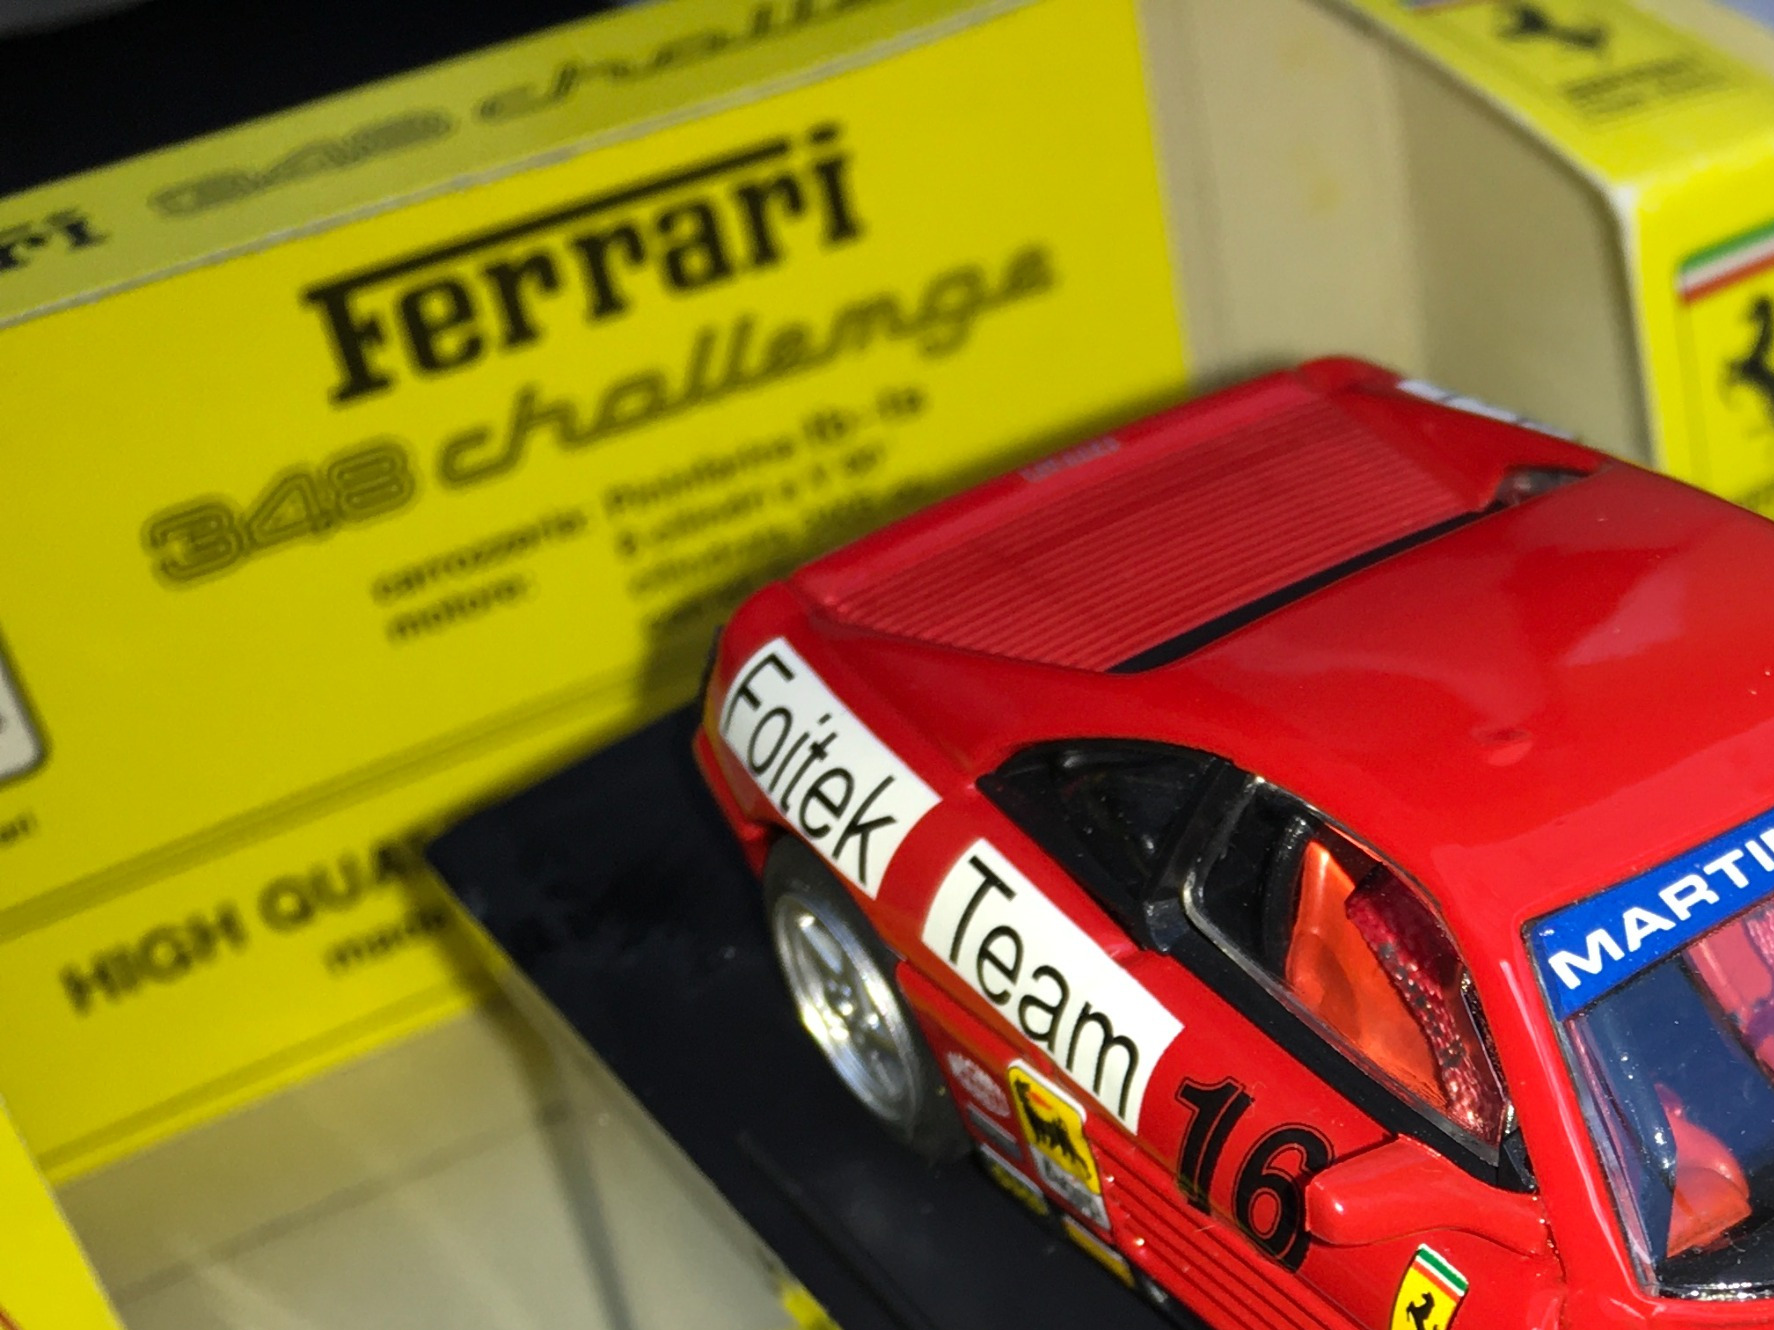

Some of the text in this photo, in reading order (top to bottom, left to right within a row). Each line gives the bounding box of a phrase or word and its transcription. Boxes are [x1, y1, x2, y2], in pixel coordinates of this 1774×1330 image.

[300, 121, 866, 407] Ferrari
[141, 241, 1058, 588] 348 challenge
[59, 899, 250, 1017] HIGH
[722, 652, 1140, 1121] Foitek Team
[1174, 1076, 1335, 1274] 16
